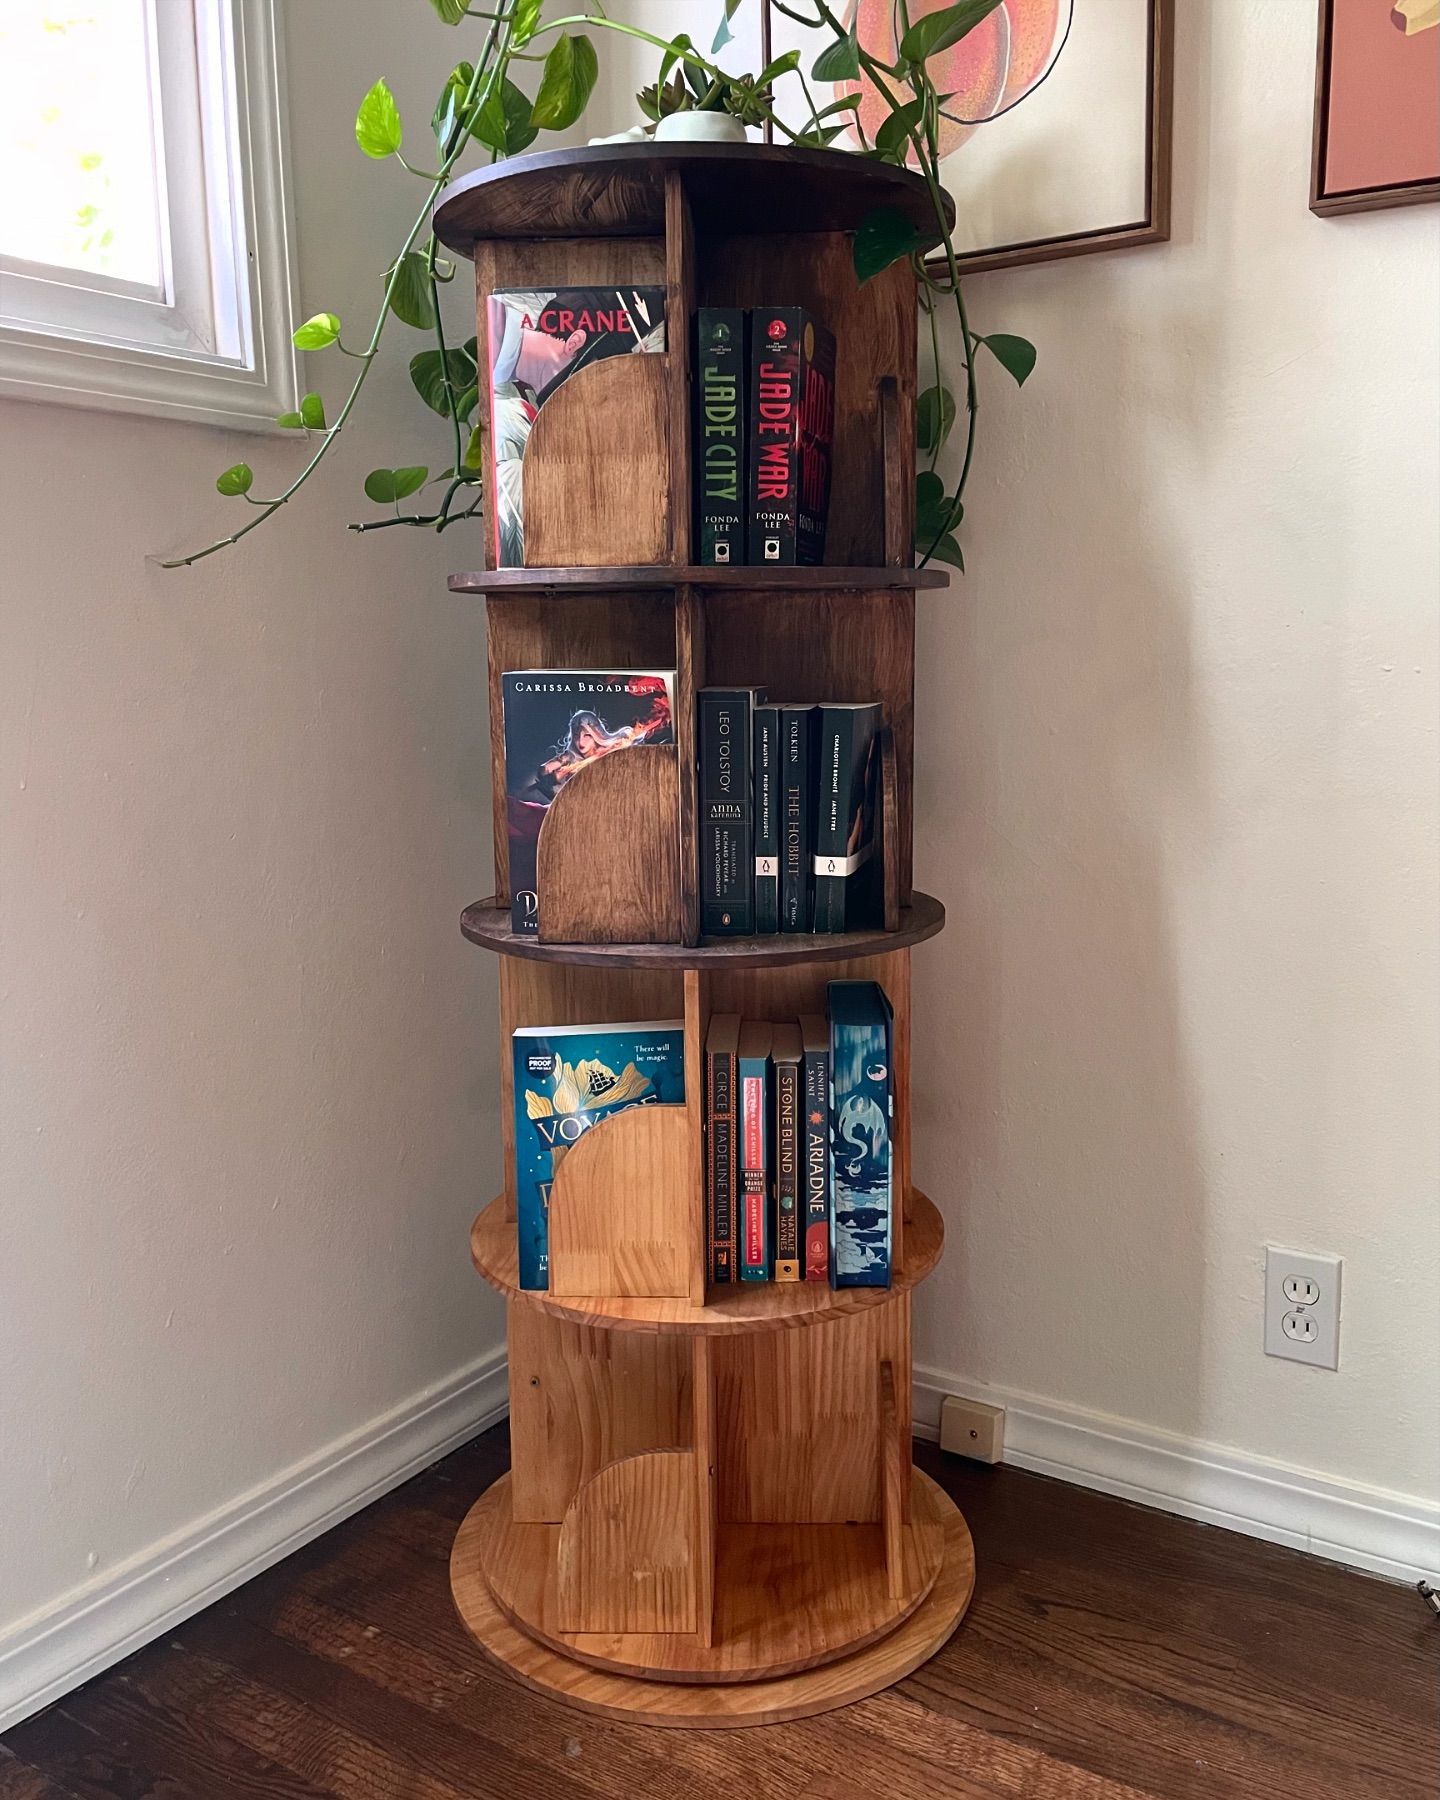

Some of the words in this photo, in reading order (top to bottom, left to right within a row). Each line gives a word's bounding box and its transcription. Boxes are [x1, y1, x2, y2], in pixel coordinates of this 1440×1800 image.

[520, 313, 534, 329] A
[540, 310, 633, 334] CRANE
[774, 325, 780, 335] 2
[704, 366, 736, 437] JADE
[759, 363, 791, 434] JADE
[705, 444, 737, 501] CITY
[758, 442, 789, 500] WAR
[714, 524, 731, 532] LEE
[756, 512, 790, 521] FONDA
[765, 521, 781, 529] LEE
[515, 682, 571, 692] CARISSA
[578, 682, 656, 693] BROADBENT
[719, 711, 730, 735] LEO
[790, 720, 799, 763] TOLKIEN
[719, 739, 731, 793] TOLSTOY
[710, 804, 741, 813] ANNA
[788, 785, 800, 817] THE
[788, 822, 800, 876] HOBBIT
[634, 1044, 654, 1053] There
[656, 1043, 670, 1052] will
[636, 1053, 644, 1062] be
[716, 1071, 728, 1110] CIRCE
[781, 1077, 793, 1125] STONE
[816, 1062, 825, 1103] JENNIFER
[717, 1123, 728, 1189] MADELINE
[781, 1129, 793, 1173] BLIND
[809, 1133, 824, 1214] ARIADNE
[717, 1194, 727, 1237] MILLER
